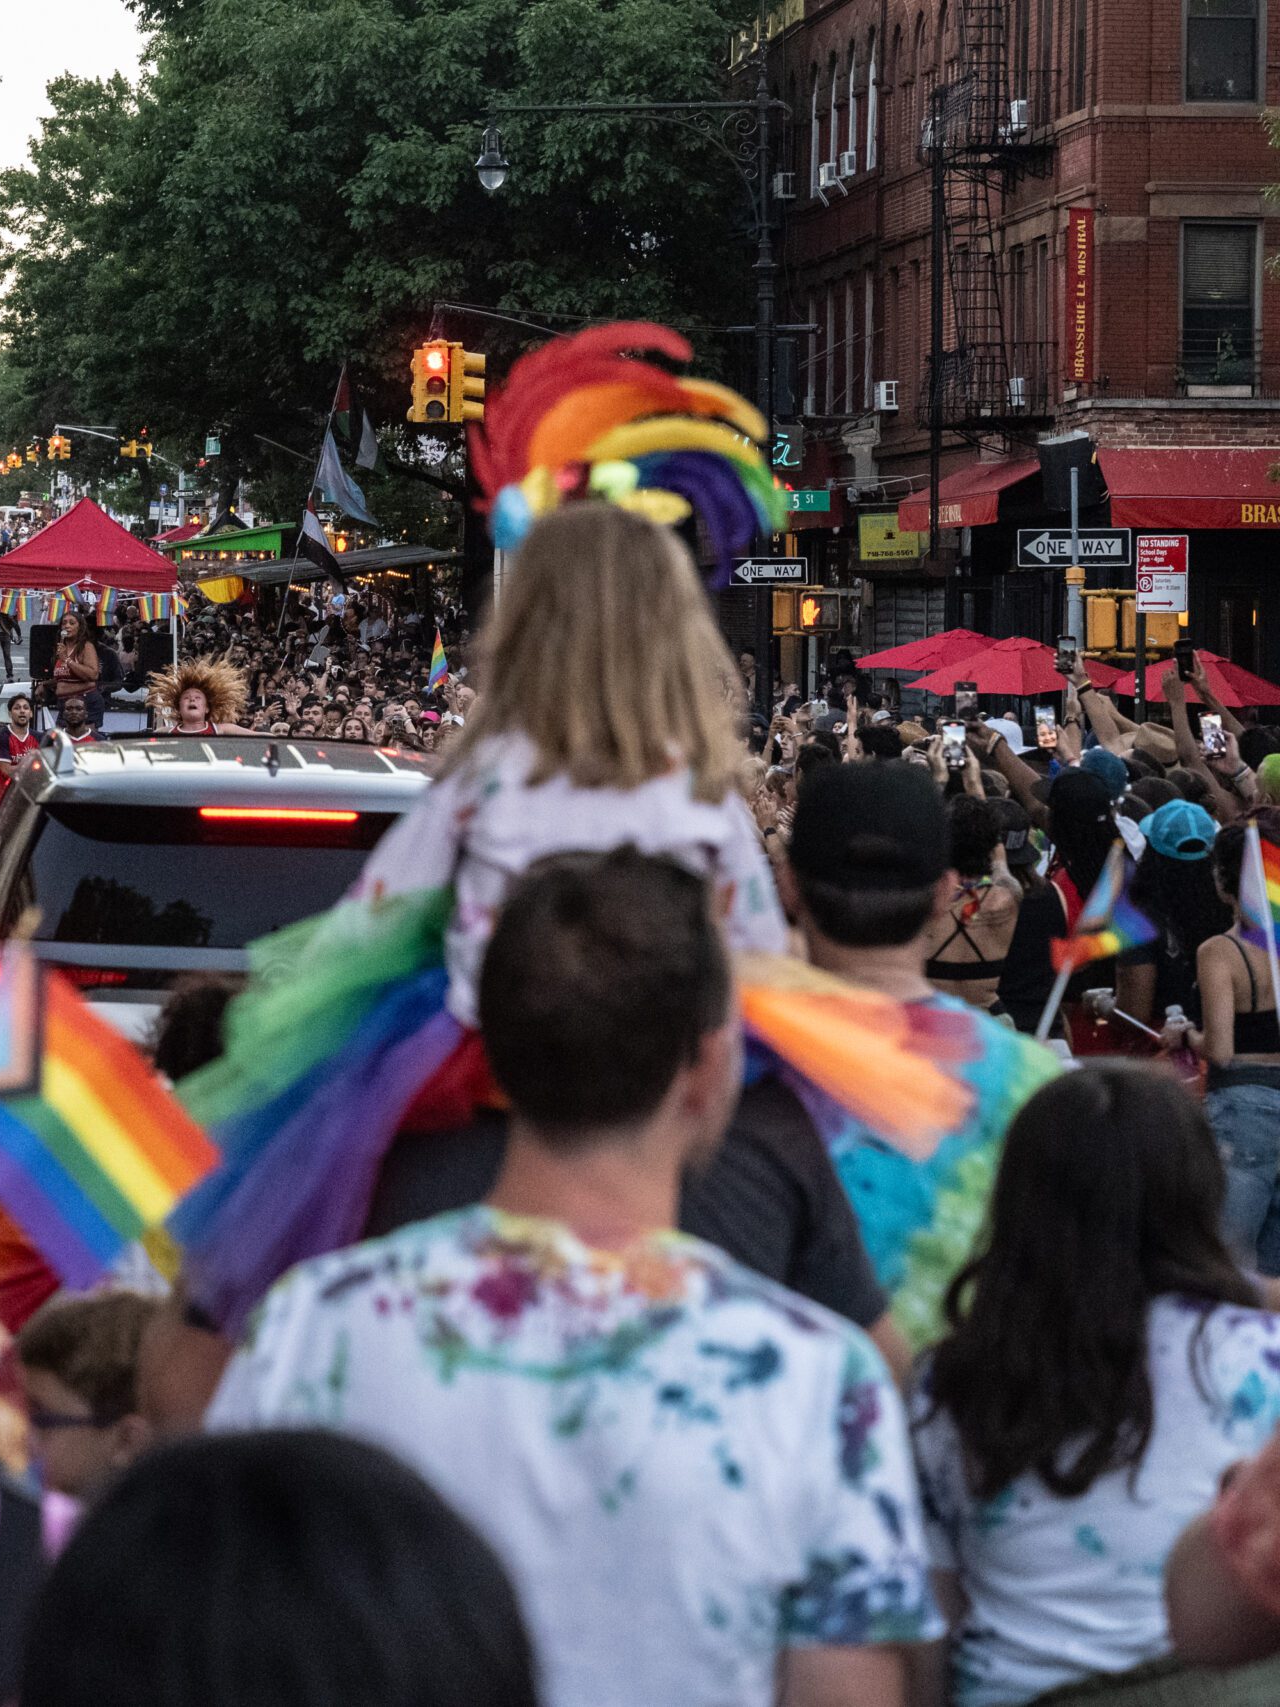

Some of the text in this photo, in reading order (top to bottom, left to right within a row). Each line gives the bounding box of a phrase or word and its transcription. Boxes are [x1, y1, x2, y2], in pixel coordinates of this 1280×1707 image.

[1074, 216, 1086, 378] BRASSERIE LE MISTRAL
[793, 494, 814, 509] 5 St
[1036, 540, 1115, 554] ONE WAY
[1140, 539, 1179, 547] NO STANDING
[742, 566, 797, 577] ONE WAY
